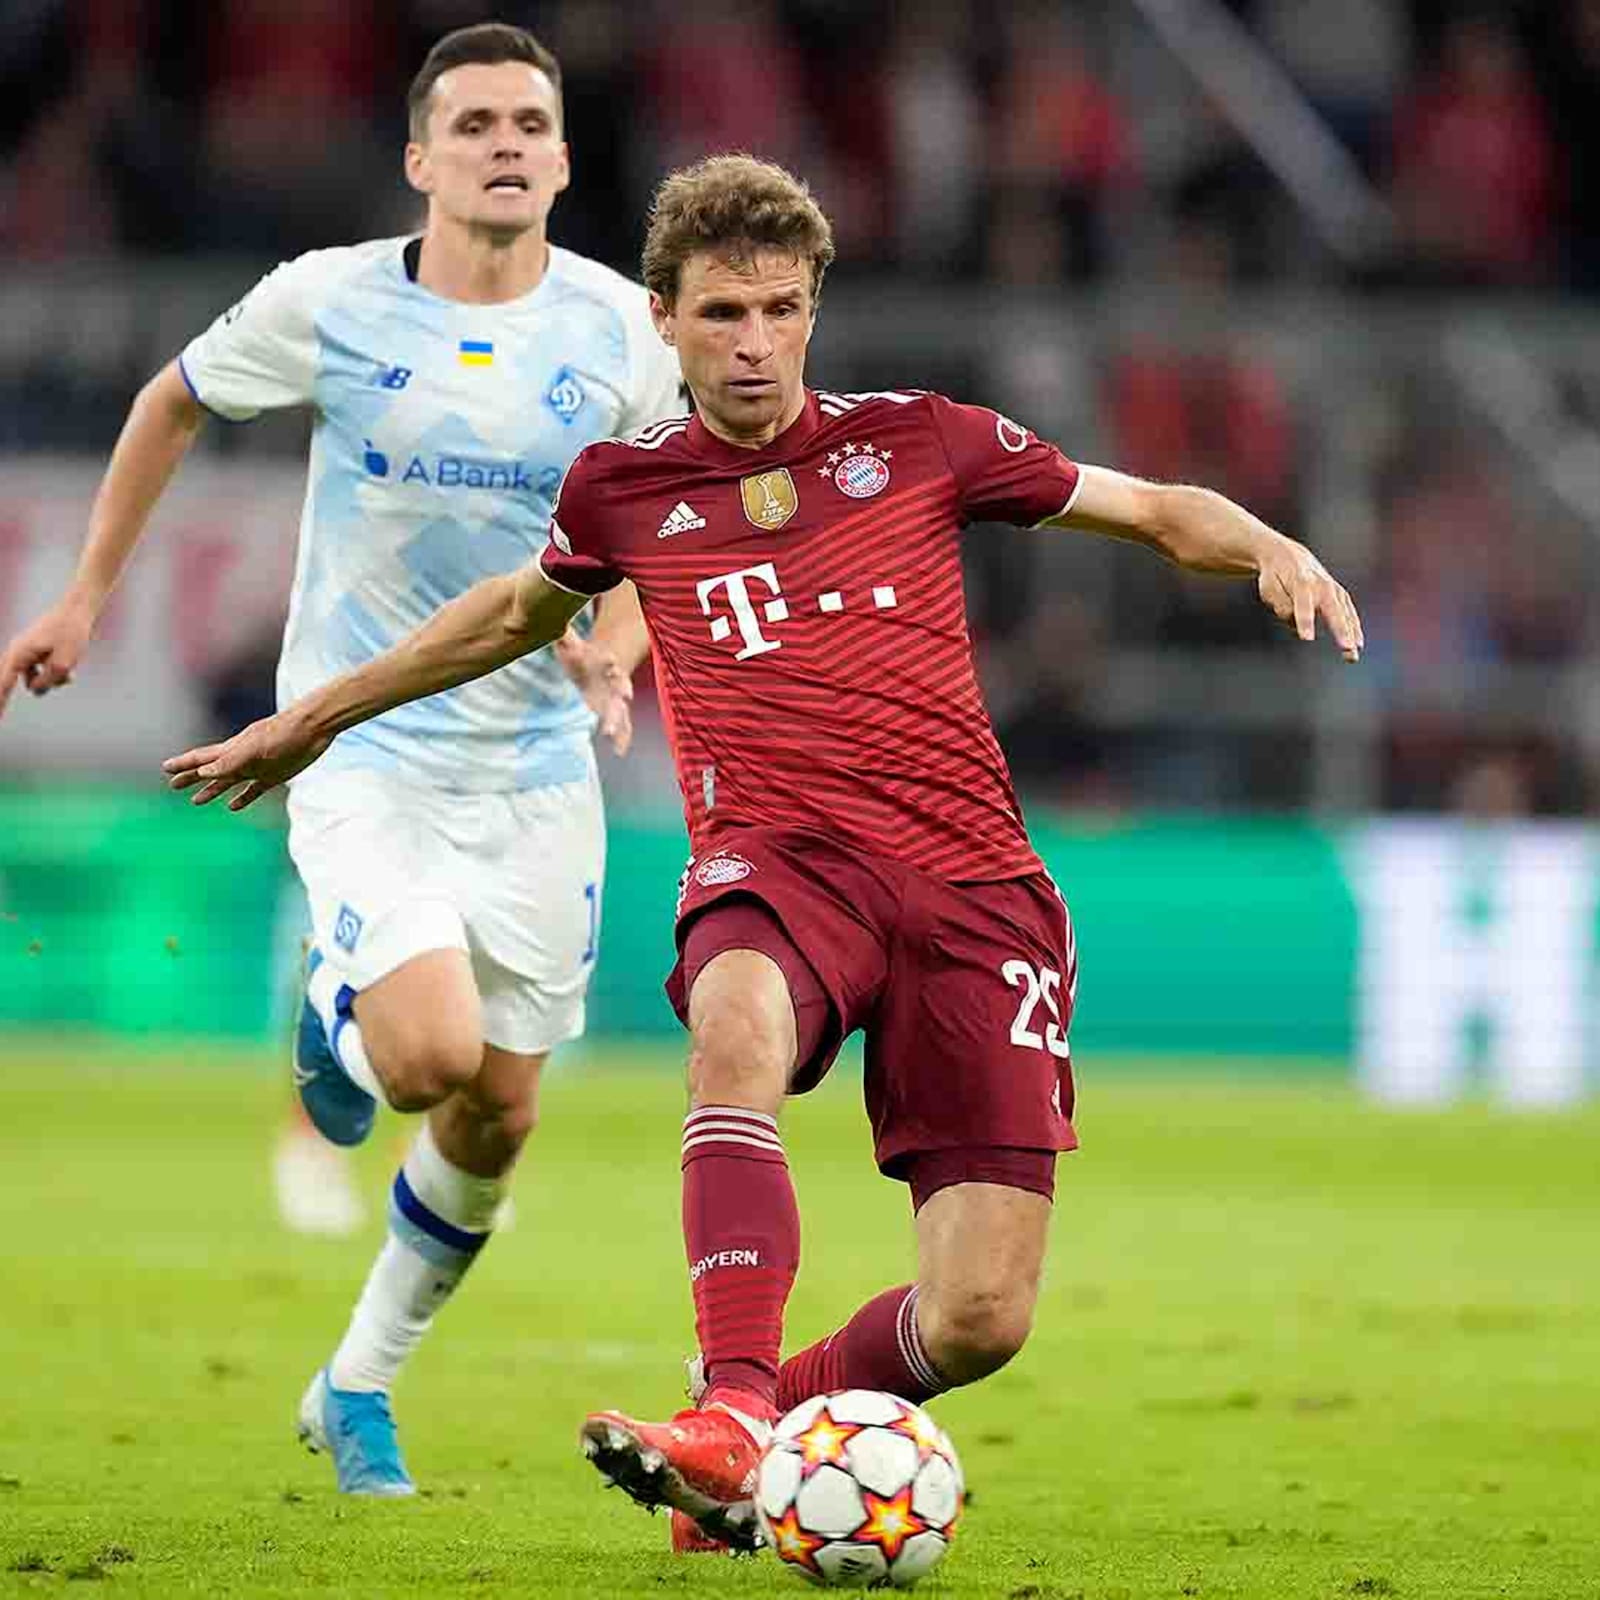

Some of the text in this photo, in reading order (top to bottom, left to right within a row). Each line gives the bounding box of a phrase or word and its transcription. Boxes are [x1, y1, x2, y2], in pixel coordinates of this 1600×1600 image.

[657, 517, 707, 539] adidas
[1001, 960, 1070, 1059] 25
[689, 1250, 759, 1281] BAYERN
